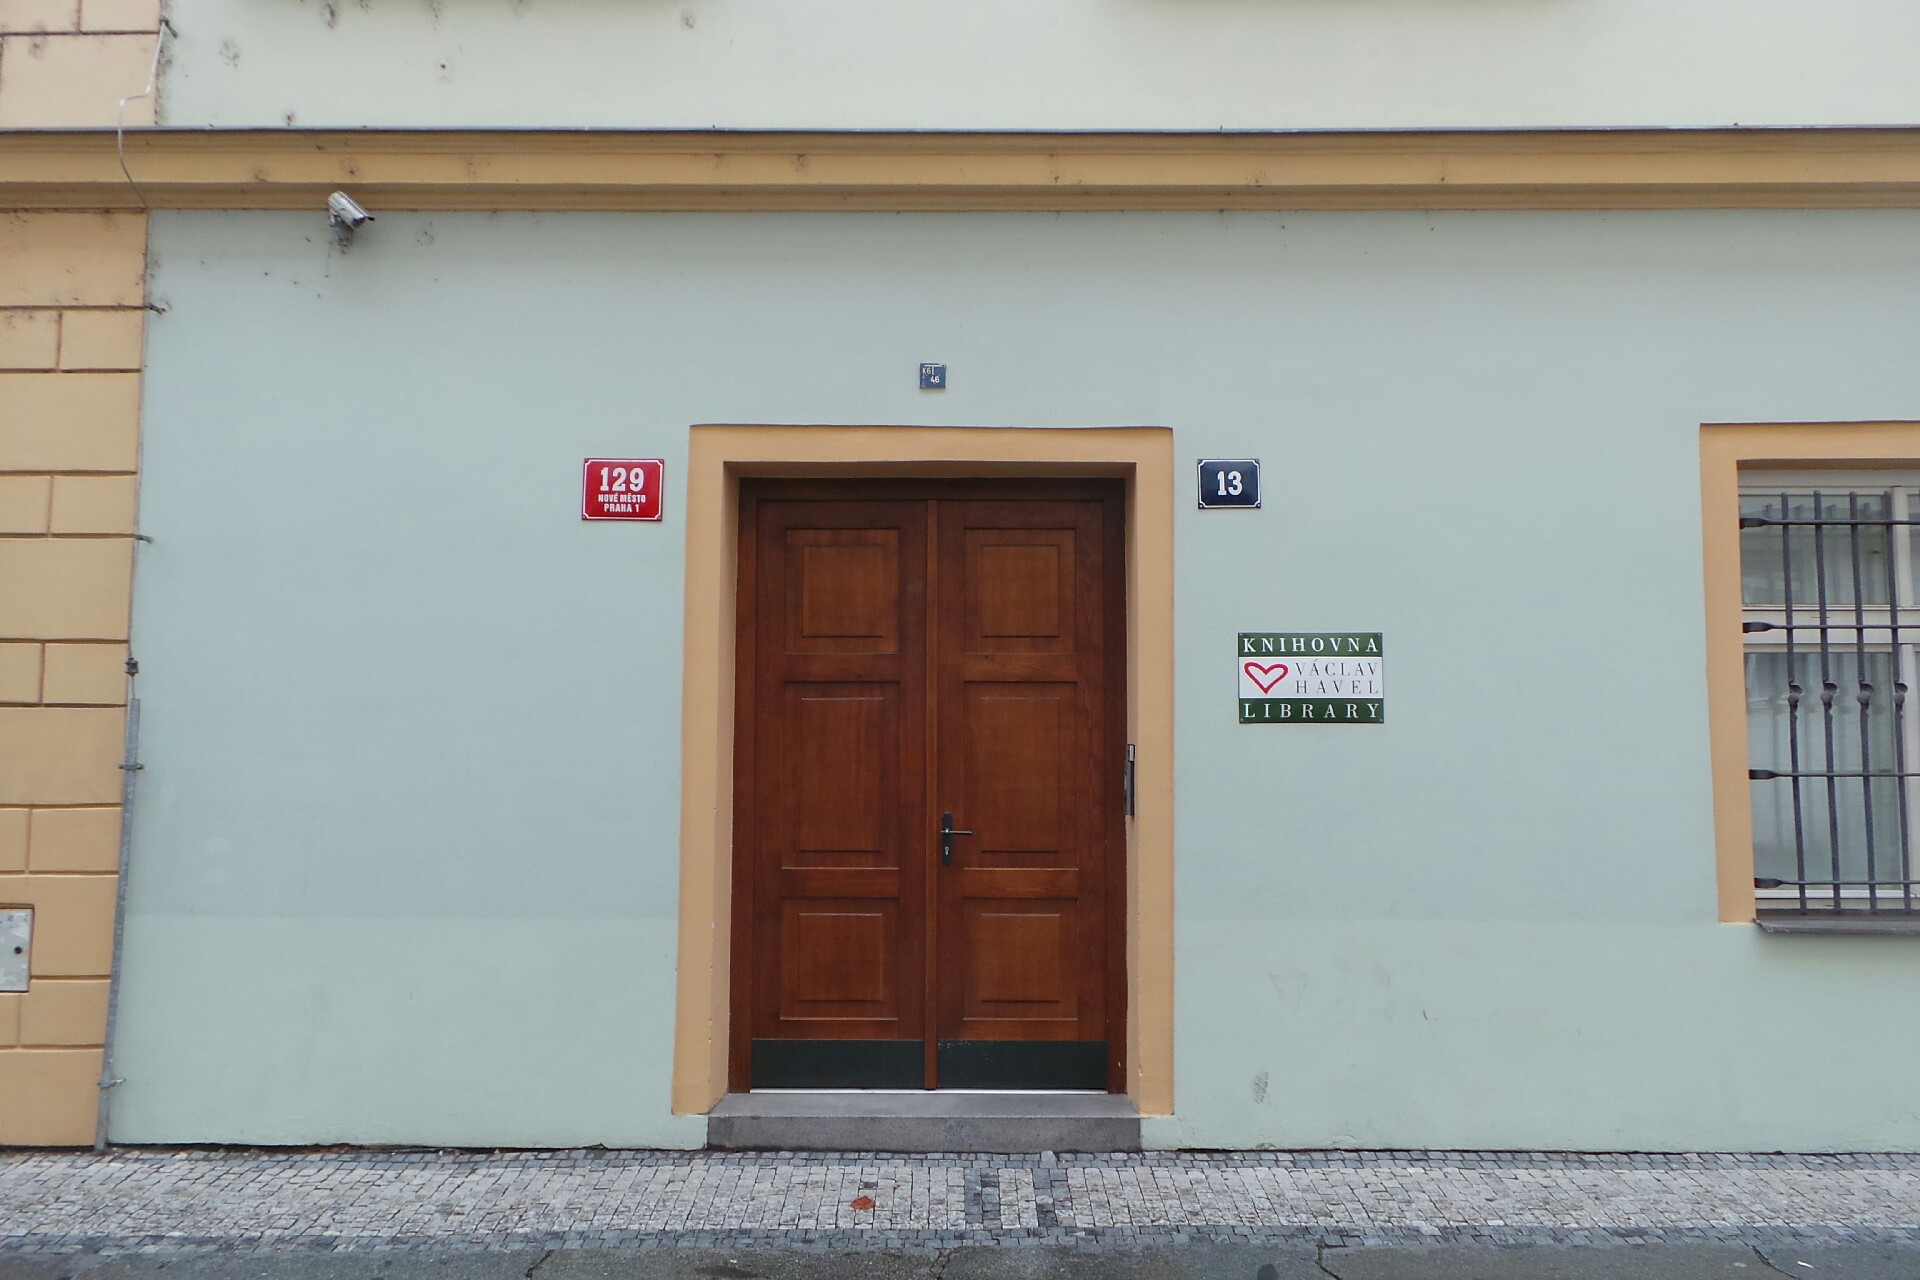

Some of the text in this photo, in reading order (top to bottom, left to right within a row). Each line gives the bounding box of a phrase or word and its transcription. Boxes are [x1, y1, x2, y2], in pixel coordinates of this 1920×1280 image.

[600, 467, 645, 492] 129
[1217, 470, 1243, 496] 13
[598, 492, 646, 503] NOVÉ MĚSTO
[604, 503, 640, 512] PRAHA 1
[1243, 637, 1378, 653] KNIHOVNA
[1295, 659, 1378, 677] VÁCLAV
[1296, 680, 1378, 695] HAVEL
[1244, 703, 1379, 719] LIBRARY
